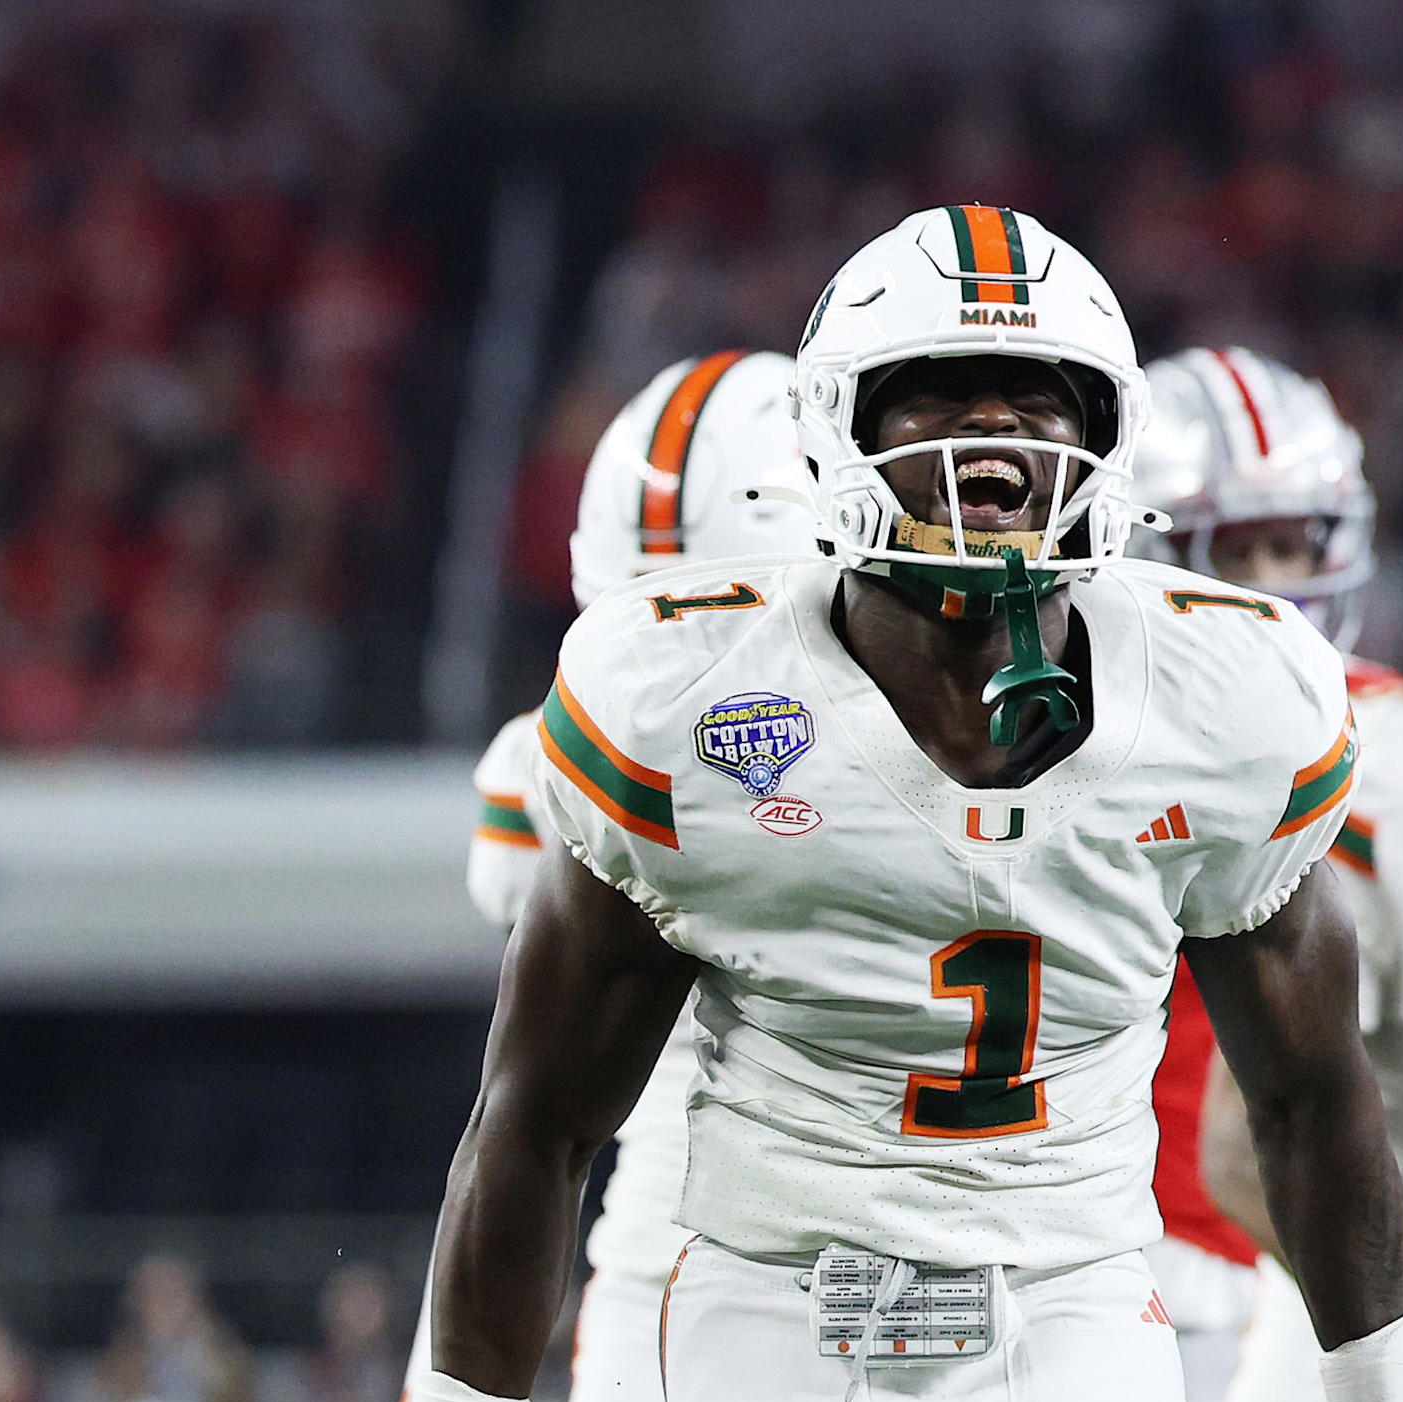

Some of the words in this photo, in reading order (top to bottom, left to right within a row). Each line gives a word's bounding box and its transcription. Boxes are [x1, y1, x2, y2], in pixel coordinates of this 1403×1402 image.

[960, 308, 1037, 329] MIAMI
[646, 582, 766, 623] 1
[1163, 588, 1283, 622] 1
[703, 703, 801, 725] GOODYEAR
[703, 716, 808, 758] COTTON
[724, 738, 790, 763] BOWL
[740, 755, 779, 775] CLASSIC
[761, 805, 813, 823] ACC
[964, 807, 1026, 842] U
[900, 928, 1049, 1139] 1
